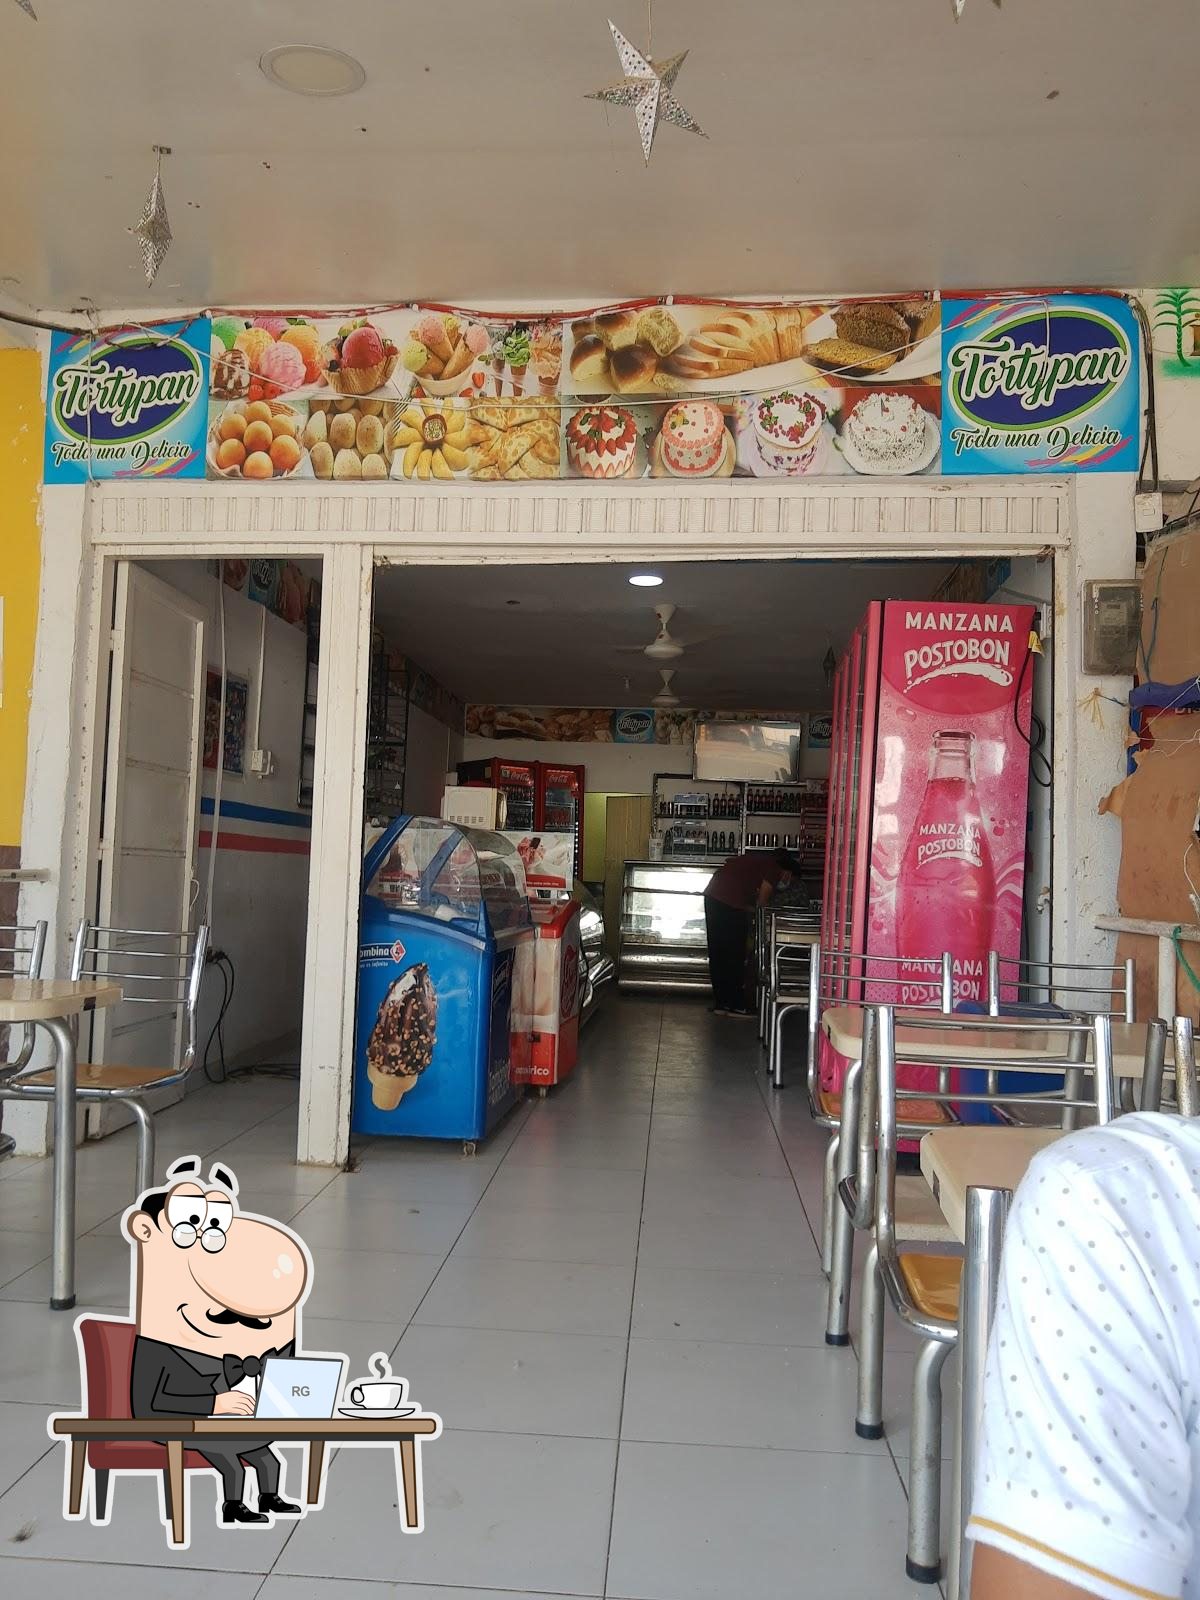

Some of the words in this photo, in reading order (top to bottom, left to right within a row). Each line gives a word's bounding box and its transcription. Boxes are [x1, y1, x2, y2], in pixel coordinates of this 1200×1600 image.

[950, 337, 1128, 407] Tortypan
[54, 360, 200, 425] Tortypan
[52, 441, 92, 466] Toda
[96, 446, 127, 459] una
[131, 440, 192, 468] Delicia
[951, 426, 1001, 455] Toda
[1005, 431, 1040, 447] una
[1046, 424, 1121, 457] Delicia
[905, 611, 1014, 633] MANZANA
[903, 638, 1010, 679] POSTOBON
[919, 823, 981, 839] MANZANA
[917, 838, 980, 863] POSTOBON
